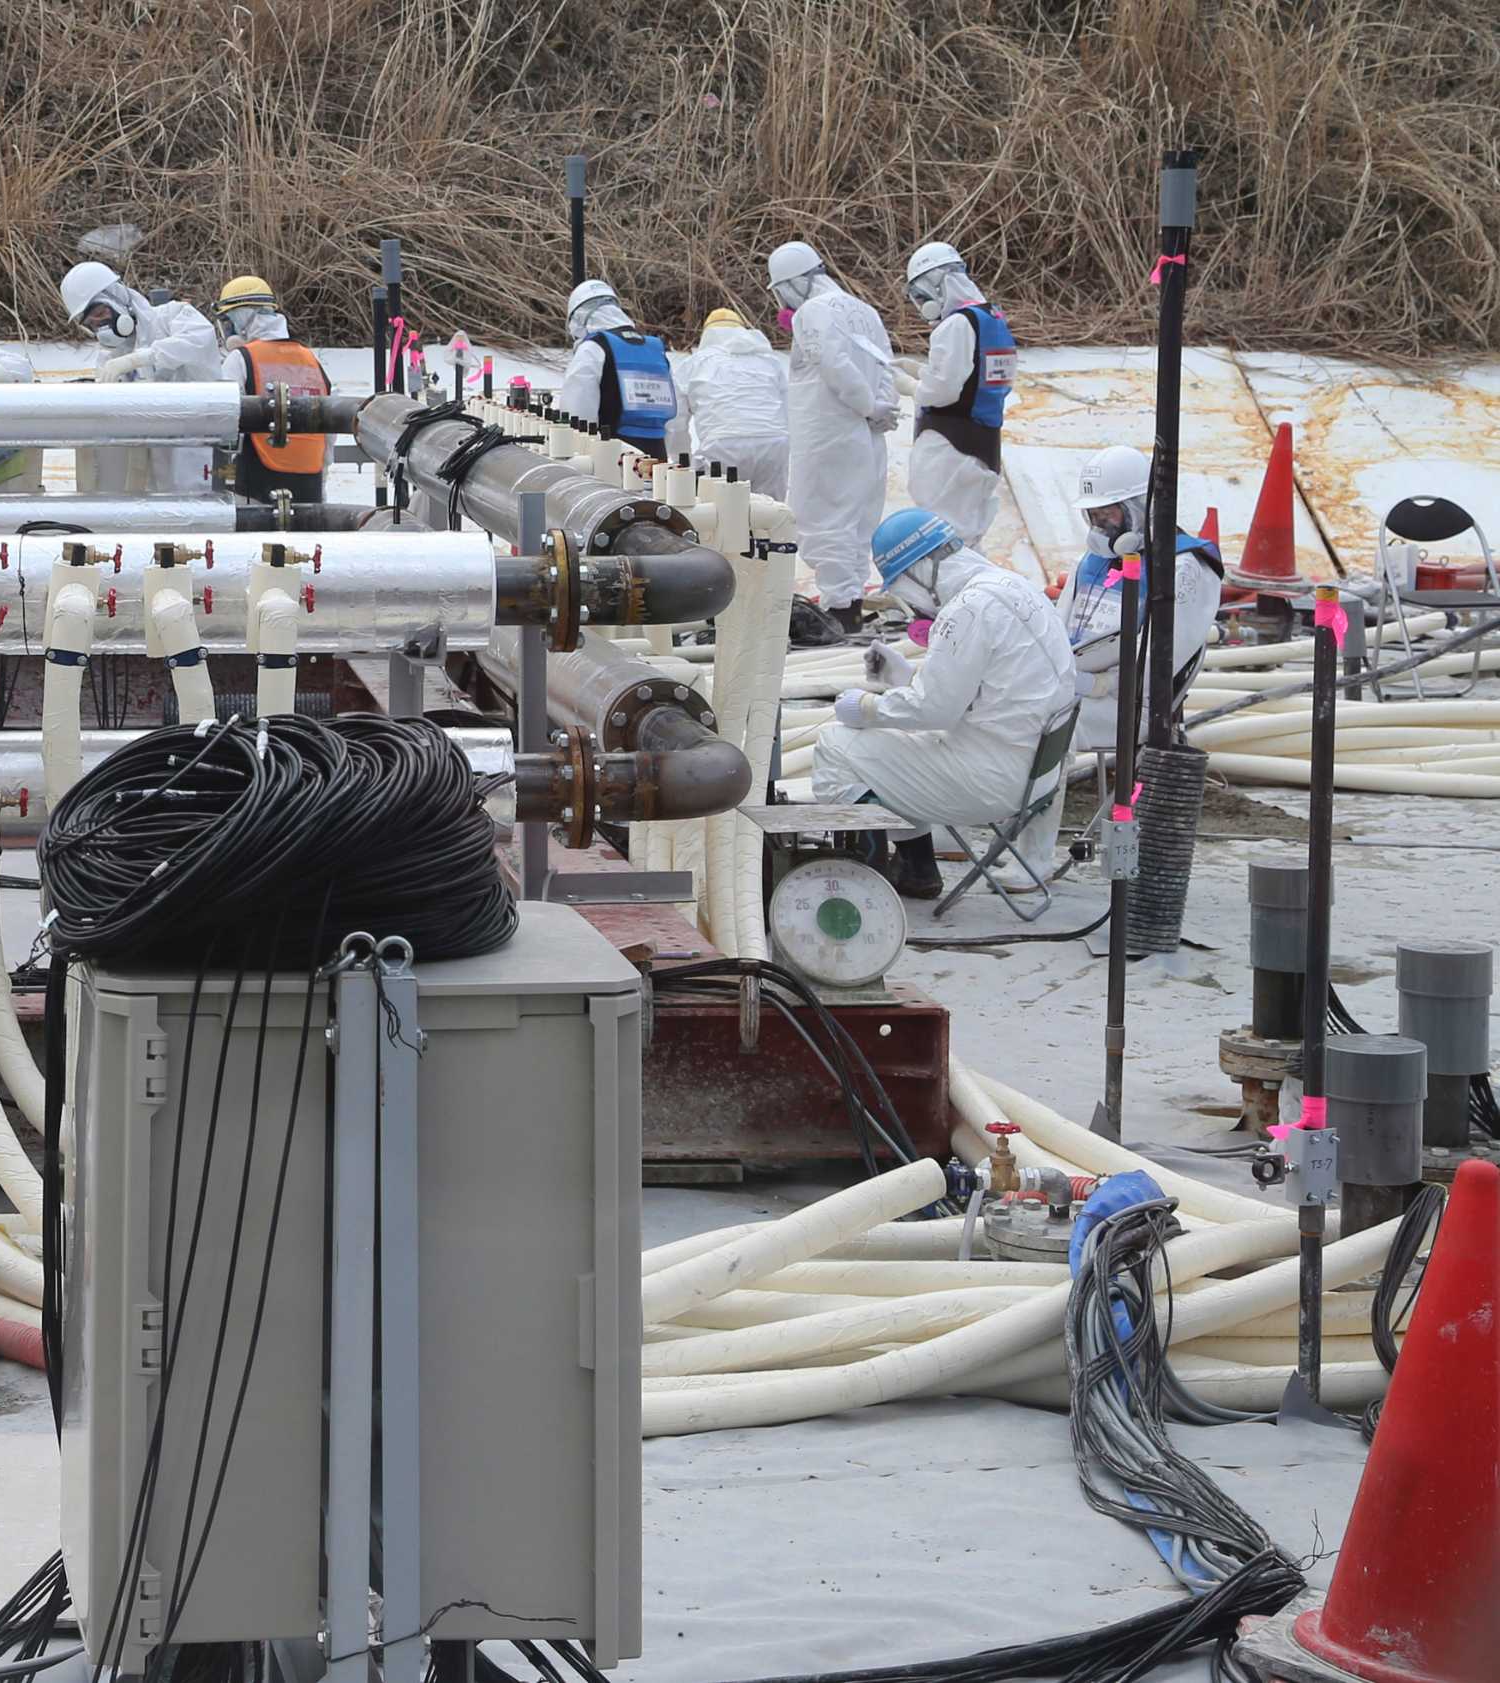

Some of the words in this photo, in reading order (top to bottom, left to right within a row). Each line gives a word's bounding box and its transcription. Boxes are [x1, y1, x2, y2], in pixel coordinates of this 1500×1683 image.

[824, 879, 839, 892] 30
[795, 898, 810, 911] 25
[865, 898, 873, 909] 5
[863, 933, 875, 945] 10
